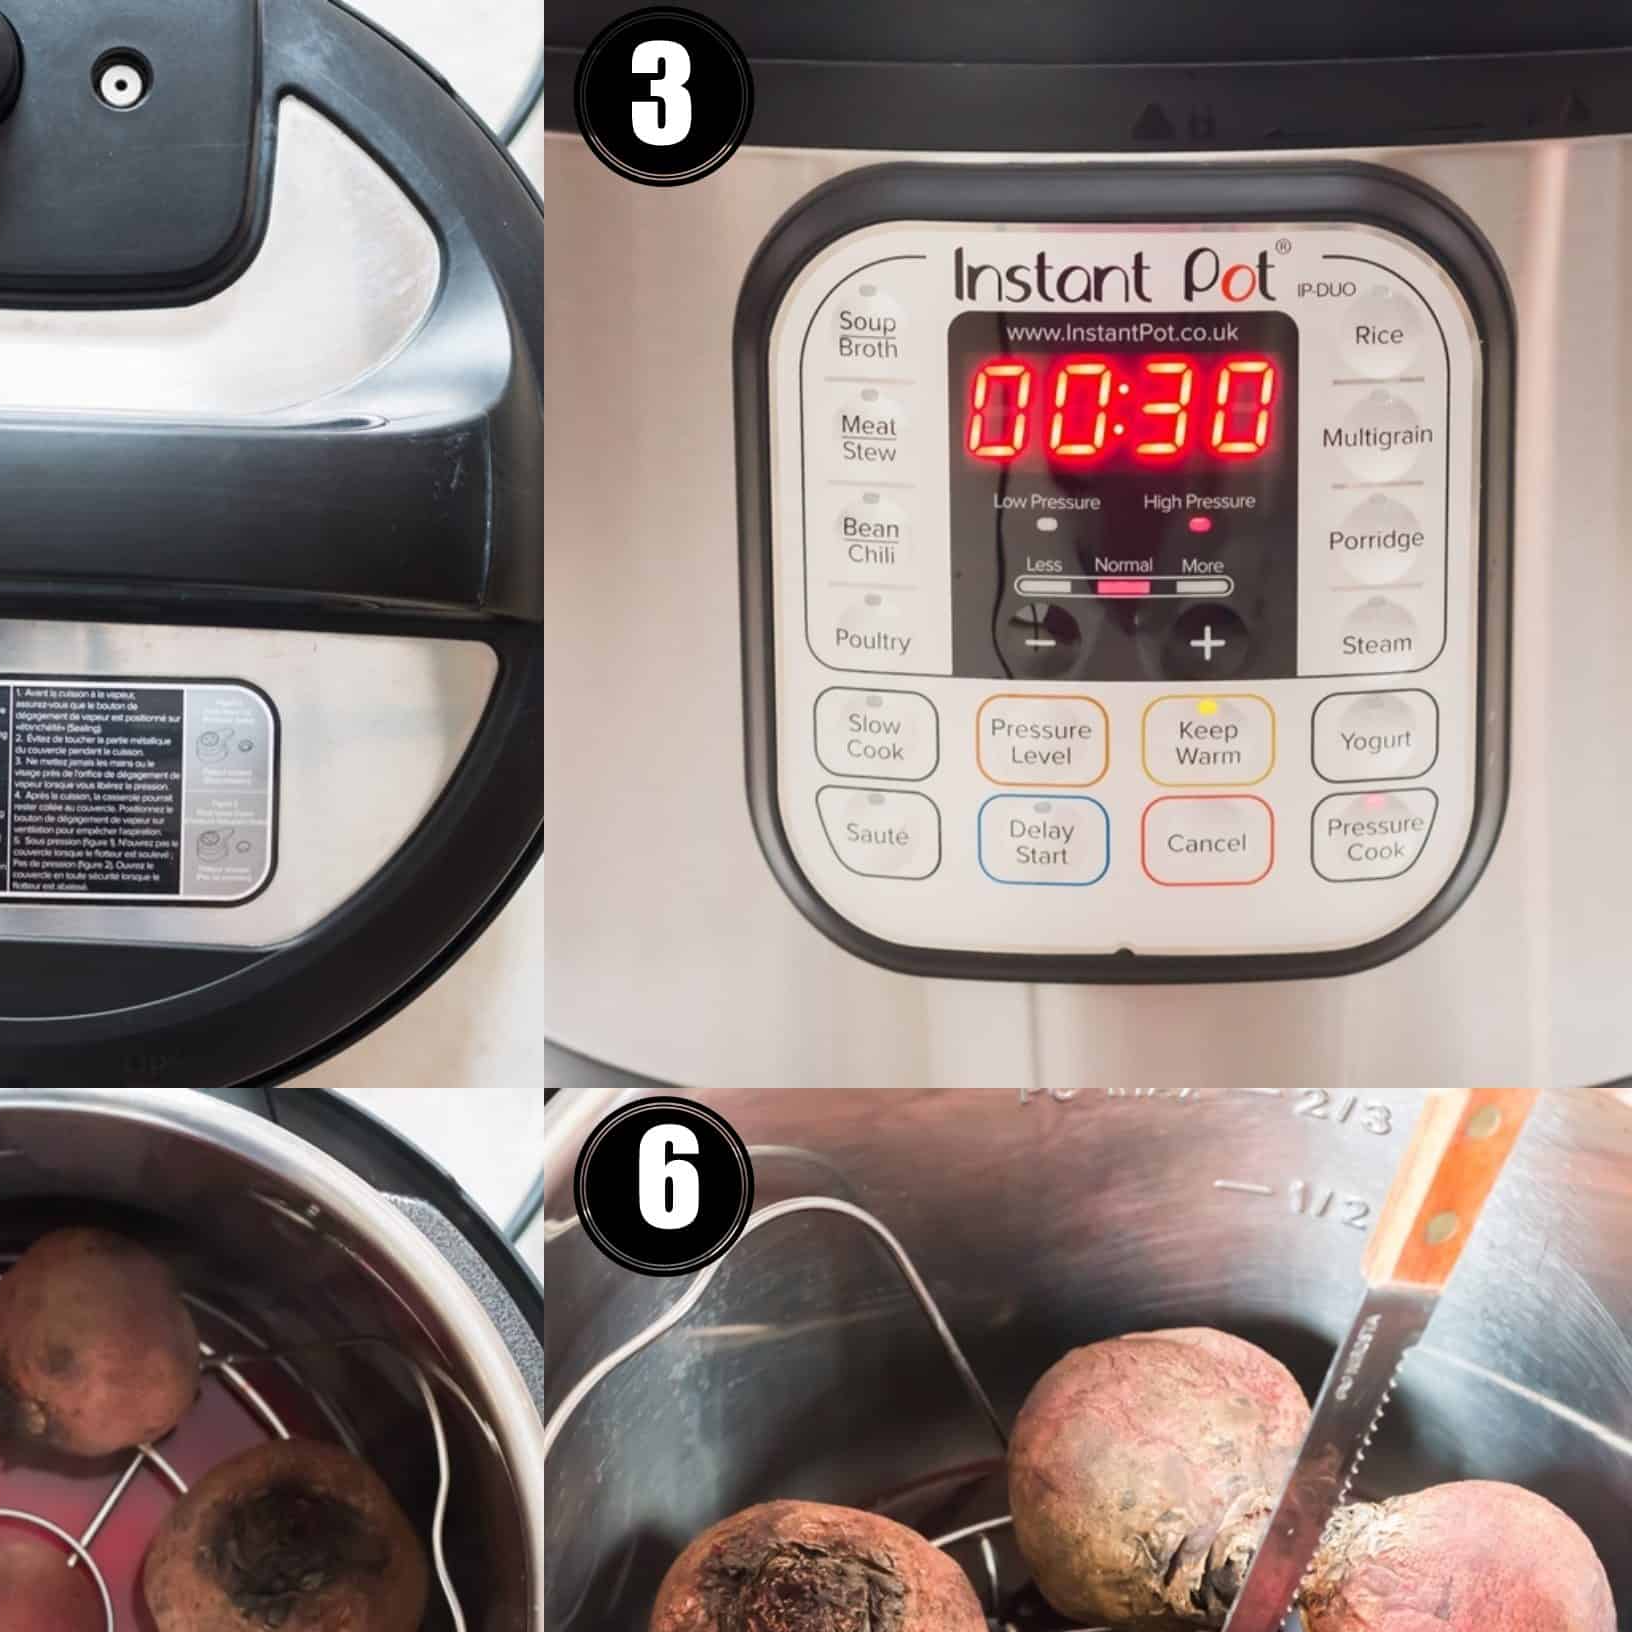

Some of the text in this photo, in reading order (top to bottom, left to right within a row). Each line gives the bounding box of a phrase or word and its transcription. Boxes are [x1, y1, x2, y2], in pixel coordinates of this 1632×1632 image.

[955, 248, 1152, 303] Instant
[1298, 282, 1356, 297] IP-DUO
[840, 310, 896, 335] Soup
[1007, 323, 1238, 342] www.InstantPot.co.uk
[1356, 326, 1403, 344] Rice
[840, 337, 898, 359] Broth
[968, 360, 1276, 457] 00:30
[842, 415, 896, 436] Meat
[1323, 425, 1432, 449] Multigrain
[843, 441, 896, 462] Stew
[993, 493, 1100, 510] Low Pressure
[1145, 494, 1256, 513] High Pressure
[843, 517, 899, 538] Bean
[1330, 530, 1424, 552] Porridge
[848, 544, 894, 564] Chili
[1027, 557, 1224, 573] Less Normal More
[836, 628, 911, 655] Poultry
[1343, 636, 1411, 654] Steam
[849, 713, 900, 734] Slow
[992, 719, 1092, 740] Pressure
[1180, 721, 1238, 743] Keep
[848, 739, 904, 760] Cook
[1341, 731, 1410, 753] Yogurt
[1012, 747, 1071, 764] Level
[1176, 747, 1240, 764] Warm
[1011, 820, 1074, 844] Delay
[1328, 819, 1423, 836] Pressure
[1168, 834, 1246, 852] Cancel
[1347, 842, 1403, 861] Cook
[1017, 846, 1067, 864] Start
[1294, 1089, 1393, 1135] 2/3
[1288, 1179, 1371, 1230] 1/2
